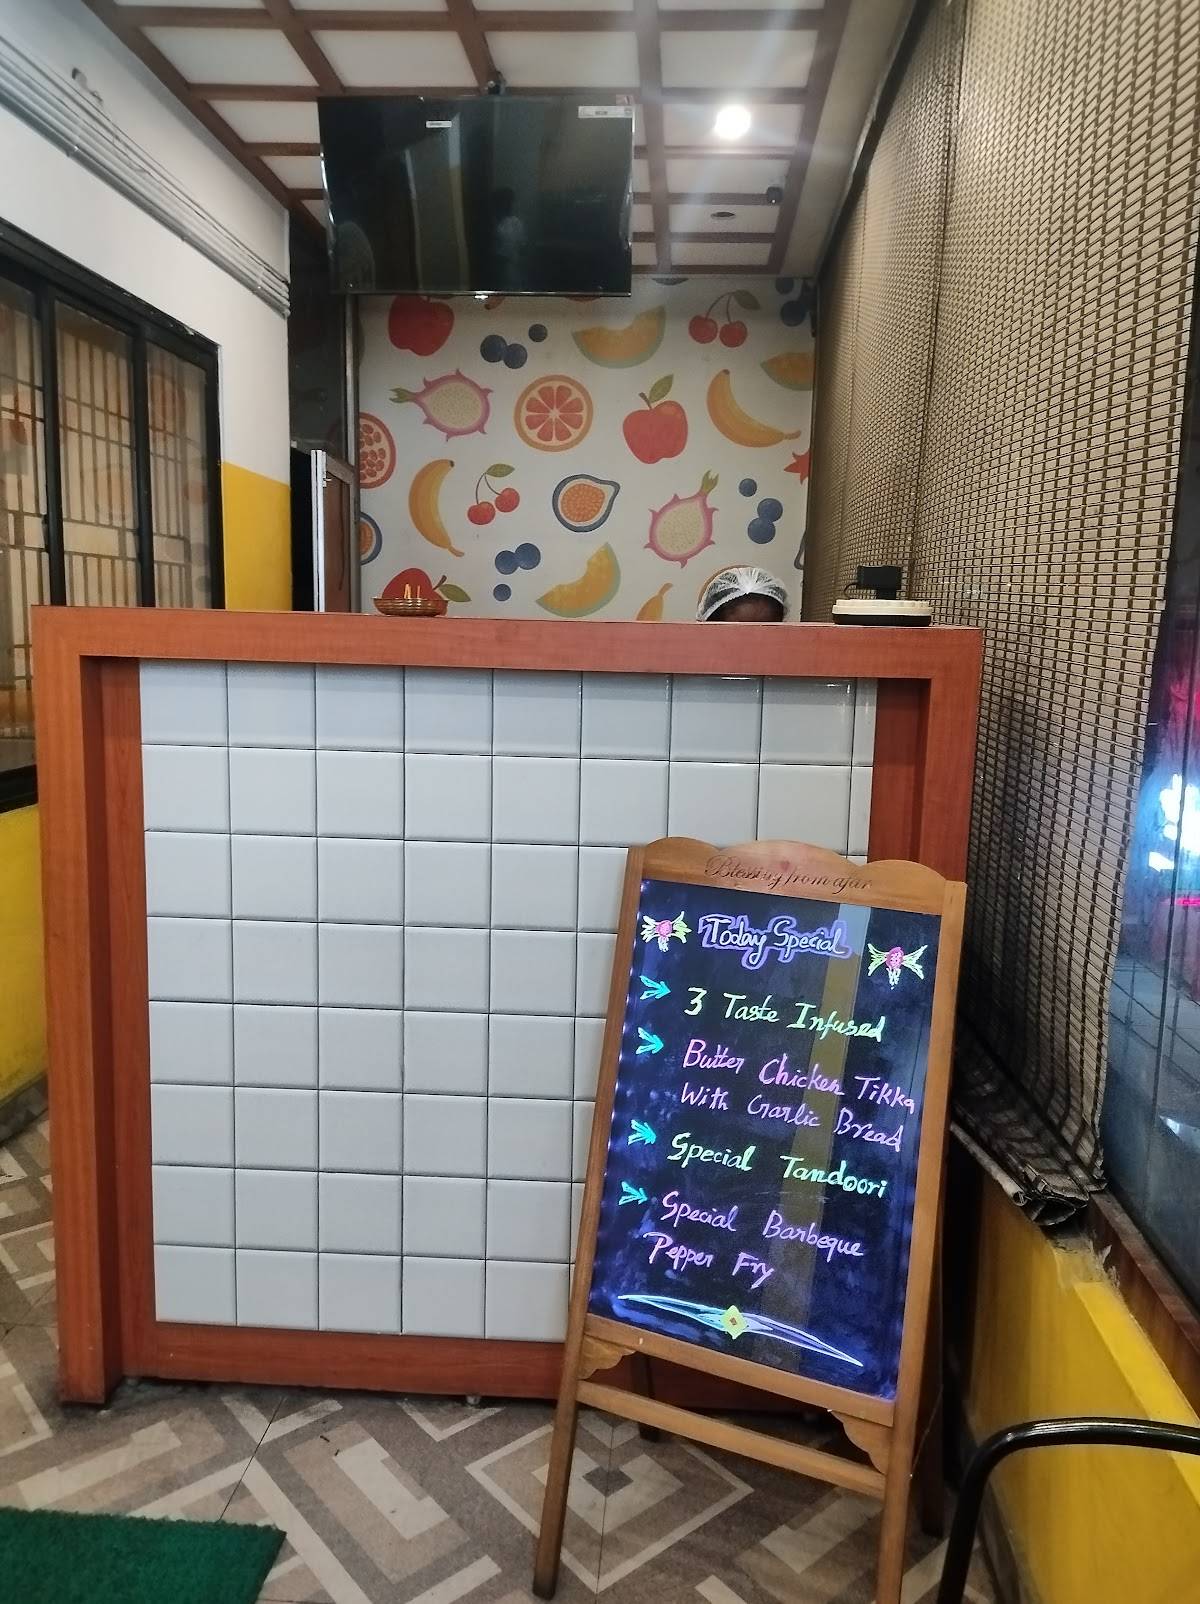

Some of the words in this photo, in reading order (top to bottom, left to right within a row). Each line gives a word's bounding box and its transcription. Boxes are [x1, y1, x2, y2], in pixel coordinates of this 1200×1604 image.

[785, 867, 829, 886] from
[706, 917, 767, 965] Today
[773, 919, 847, 958] Special
[683, 987, 709, 1017] 3
[722, 992, 781, 1024] Taste
[786, 1002, 886, 1042] Infused
[682, 1039, 745, 1074] Butter
[758, 1053, 845, 1096] Chicken
[854, 1075, 916, 1114] Tikka
[680, 1082, 728, 1111] With
[747, 1094, 821, 1127] Garlic
[833, 1107, 904, 1152] Bread
[667, 1132, 757, 1172] Special
[779, 1155, 888, 1198] Tandoori
[660, 1190, 738, 1232] Special
[762, 1210, 864, 1262] Barbeque
[643, 1231, 714, 1272] Pepper
[731, 1251, 776, 1290] Fry
